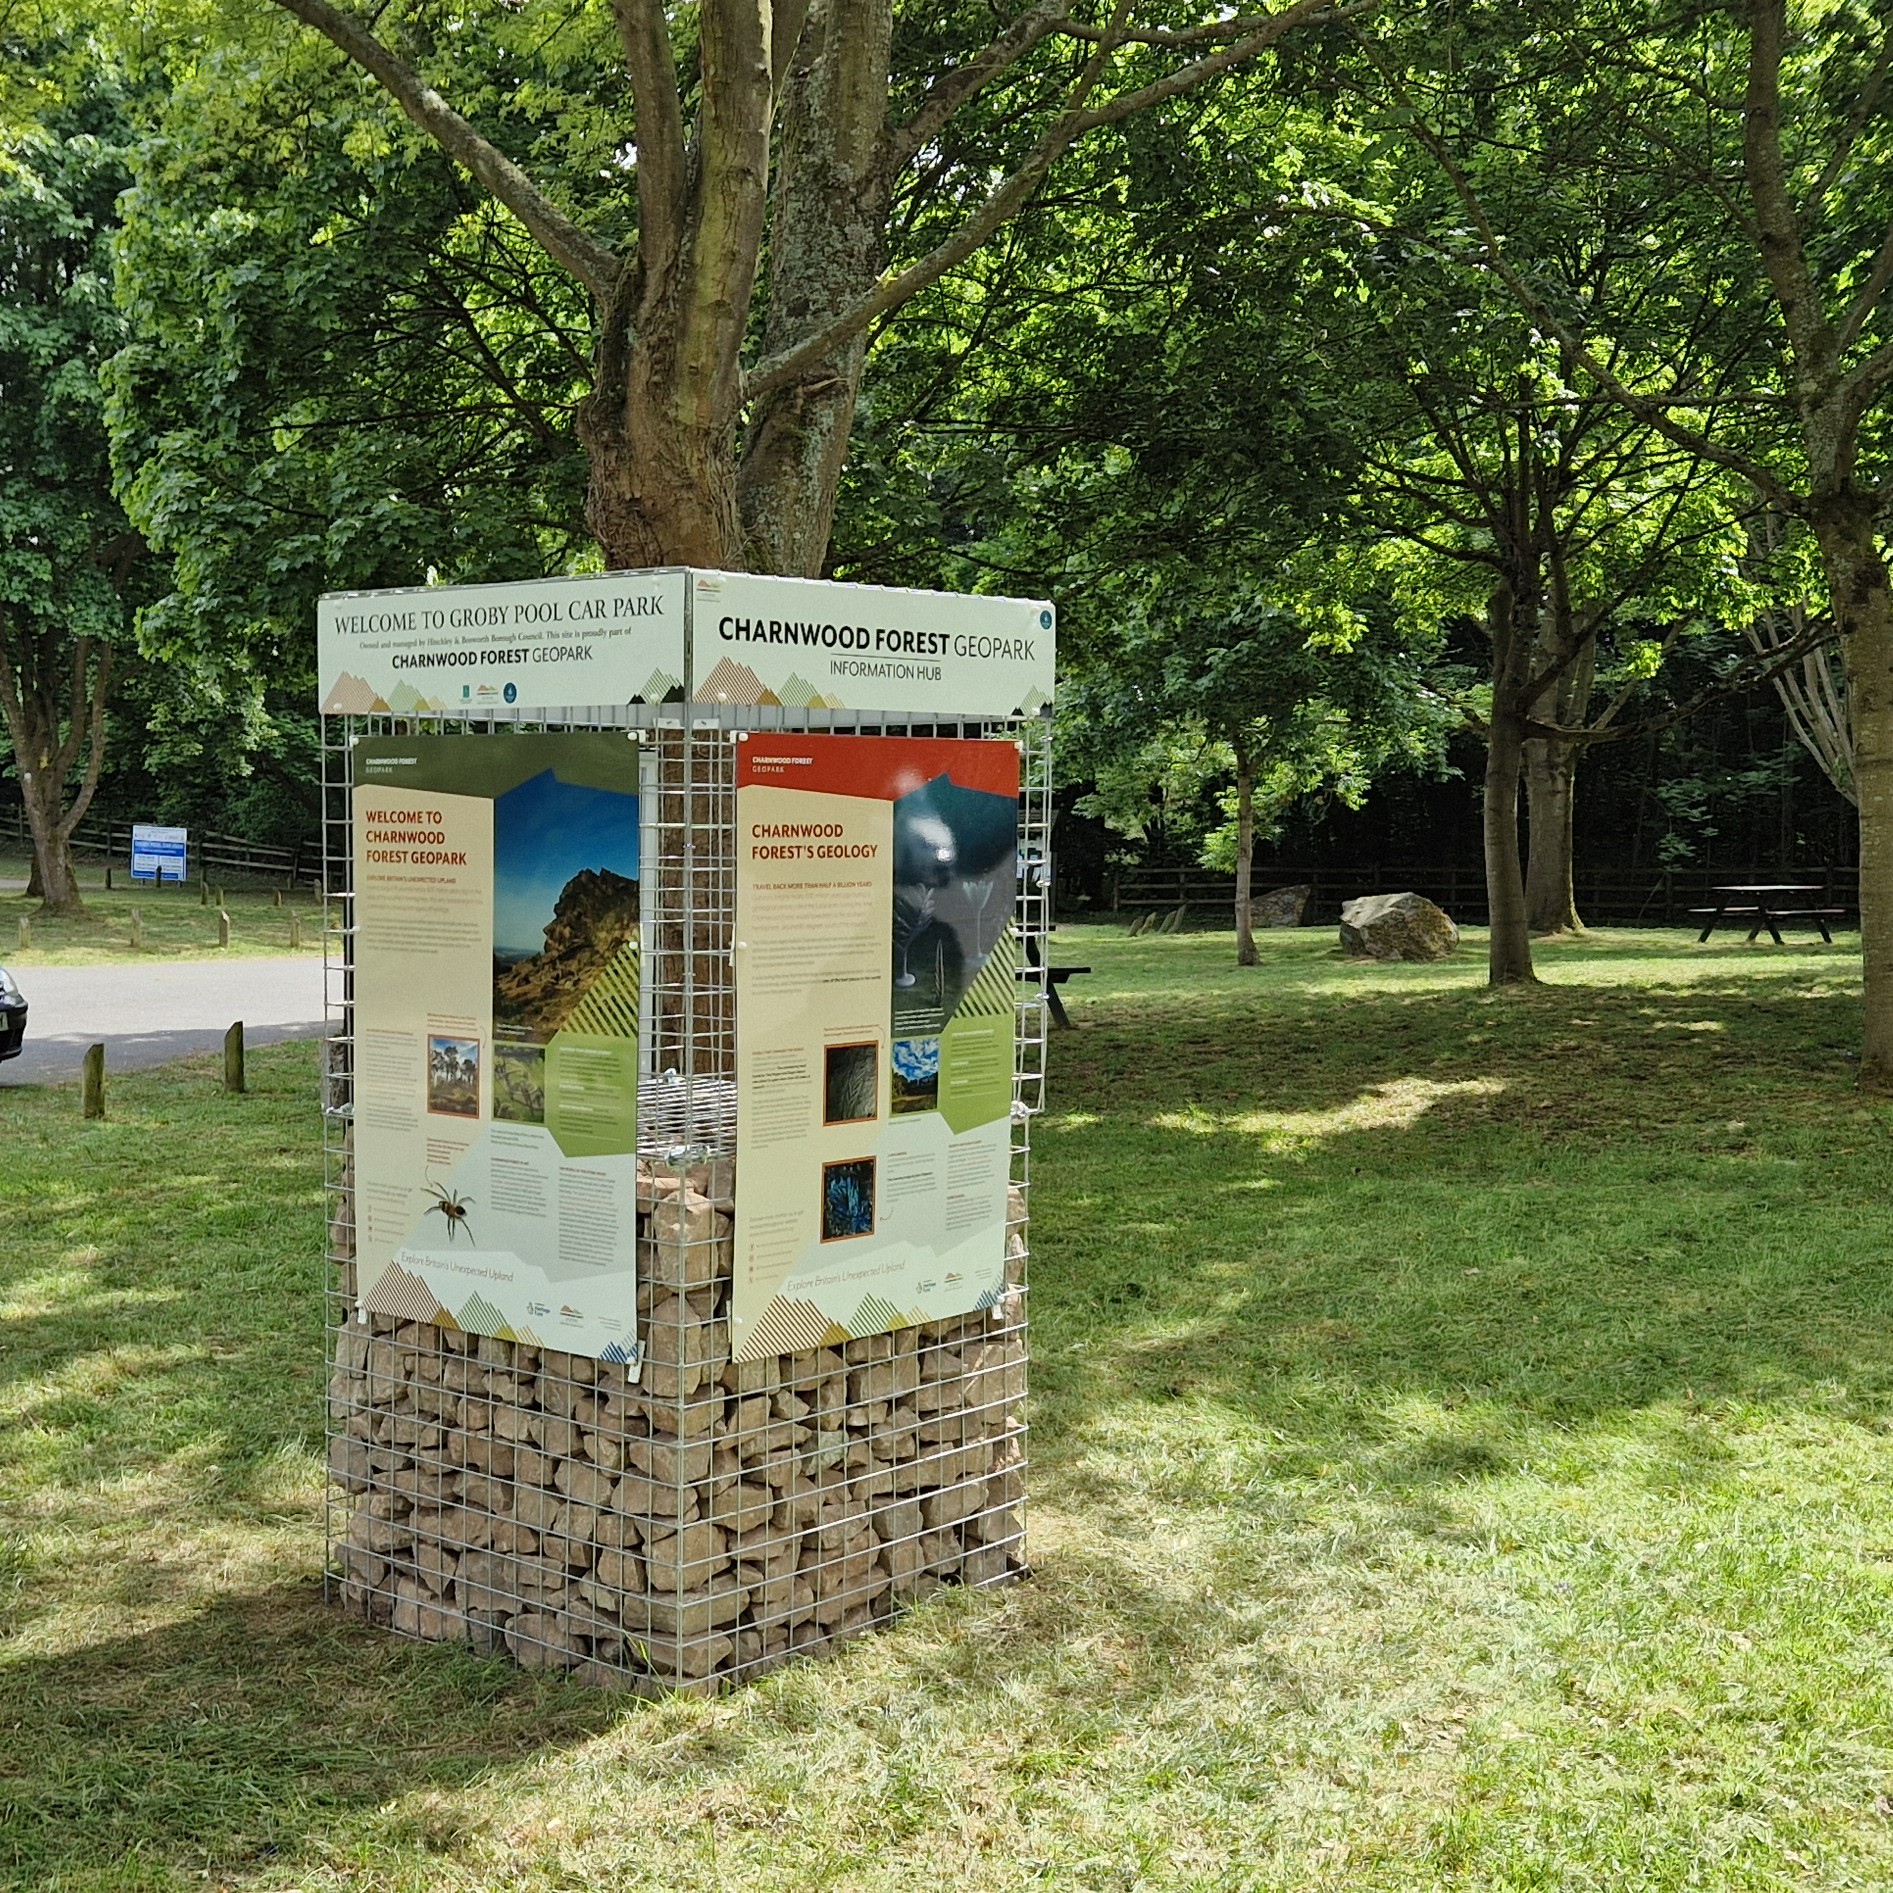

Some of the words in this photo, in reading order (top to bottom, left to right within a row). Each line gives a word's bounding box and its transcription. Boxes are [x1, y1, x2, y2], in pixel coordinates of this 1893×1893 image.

[334, 611, 418, 635] WELCOME
[421, 608, 445, 630] TO
[450, 605, 509, 628] GROBY
[514, 602, 563, 624] POOL
[568, 599, 607, 621] CAR
[613, 595, 665, 618] PARK
[547, 631, 560, 639] This
[575, 629, 580, 637] is
[582, 628, 607, 640] proudly
[608, 628, 622, 639] part
[624, 627, 631, 635] of
[719, 616, 870, 650] CHARNWOOD
[876, 628, 950, 655] FOREST
[954, 635, 1036, 661] GEOPARK
[392, 651, 478, 669] CHARNWOOD
[481, 648, 529, 665] FOREST
[532, 645, 593, 663] GEOPARK
[830, 660, 915, 680] INFORMATION
[917, 665, 942, 681] HUB
[752, 756, 791, 765] CHARNWOOD
[792, 757, 813, 765] FOREST
[752, 765, 785, 773] GEOPARK
[366, 810, 423, 824] WELCOME
[426, 811, 442, 825] TO
[366, 830, 445, 845] CHARNWOOD
[752, 824, 843, 838] CHARNWOOD
[366, 850, 408, 863] FOREST
[411, 851, 467, 865] GEOPARK
[752, 845, 814, 860] FOREST'S
[817, 844, 878, 859] GEOLOGY
[787, 882, 803, 890] MORE
